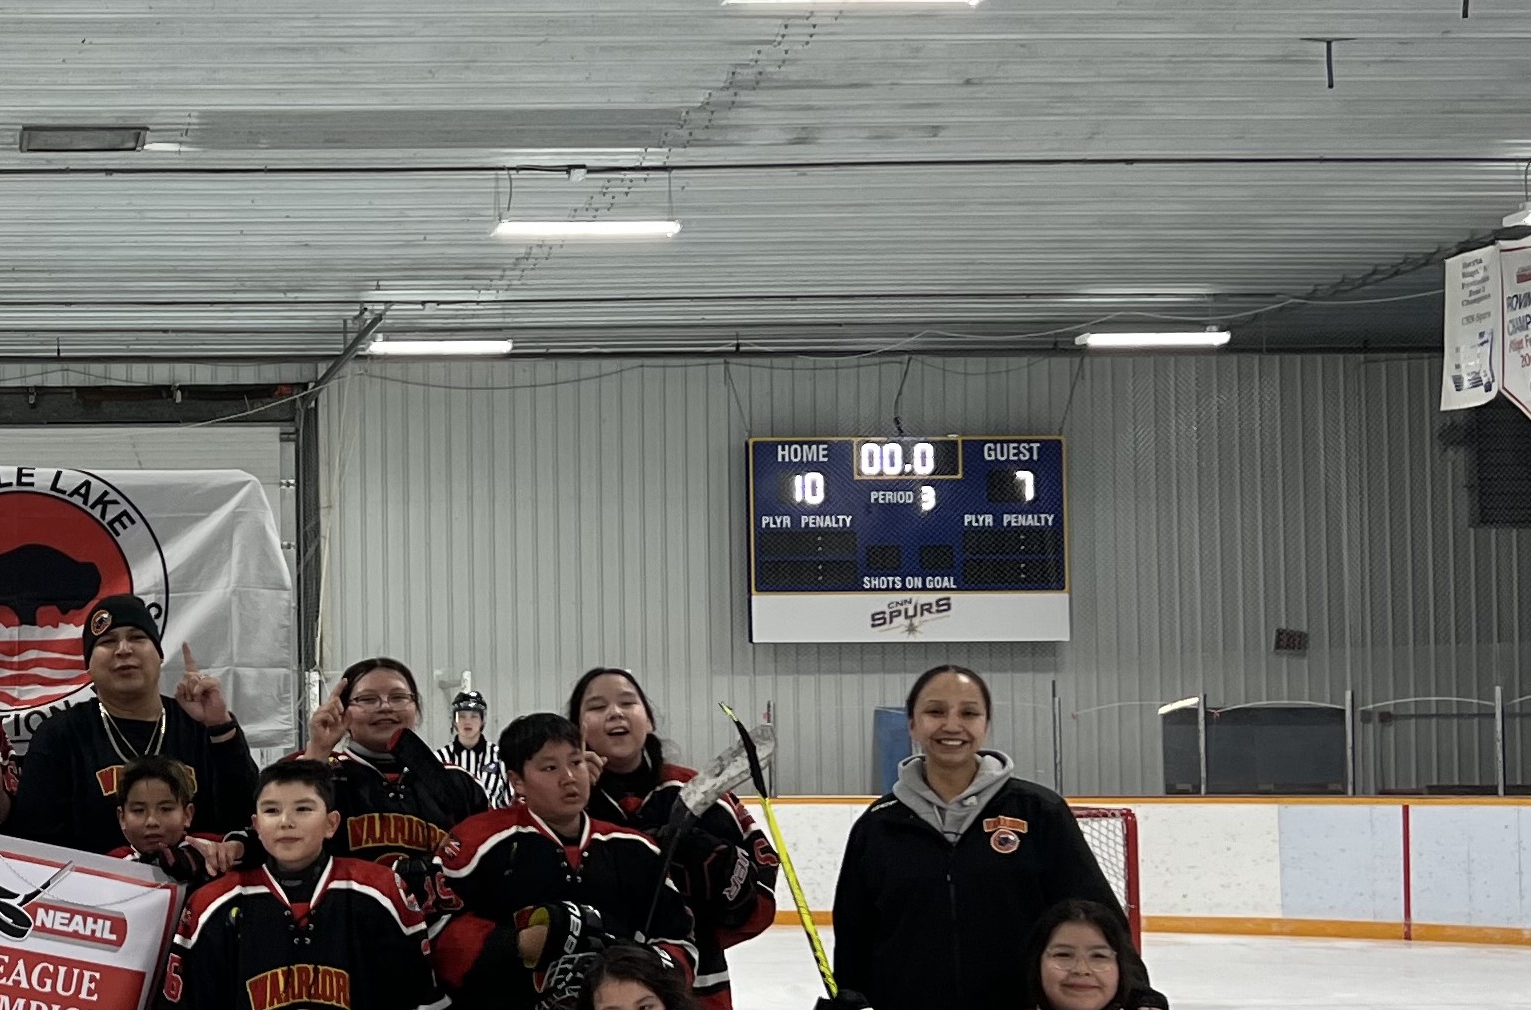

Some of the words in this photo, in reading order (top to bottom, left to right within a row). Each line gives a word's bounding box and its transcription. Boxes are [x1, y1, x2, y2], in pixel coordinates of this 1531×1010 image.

[777, 444, 828, 462] HOME
[984, 443, 1040, 461] GUEST
[794, 472, 824, 504] 10
[1015, 470, 1034, 502] 7
[49, 470, 136, 538] LAKE
[870, 491, 914, 504] PERIOD
[761, 516, 791, 529] PLYR
[801, 515, 853, 529] PENALTY
[963, 514, 994, 527] PLYR
[1002, 513, 1055, 527] PENALTY
[862, 576, 902, 589] SHOTS
[905, 576, 923, 589] ON
[925, 576, 957, 589] GOAL
[870, 596, 951, 628] SPURS
[887, 597, 913, 609] CNN
[35, 904, 117, 941] NEAHL
